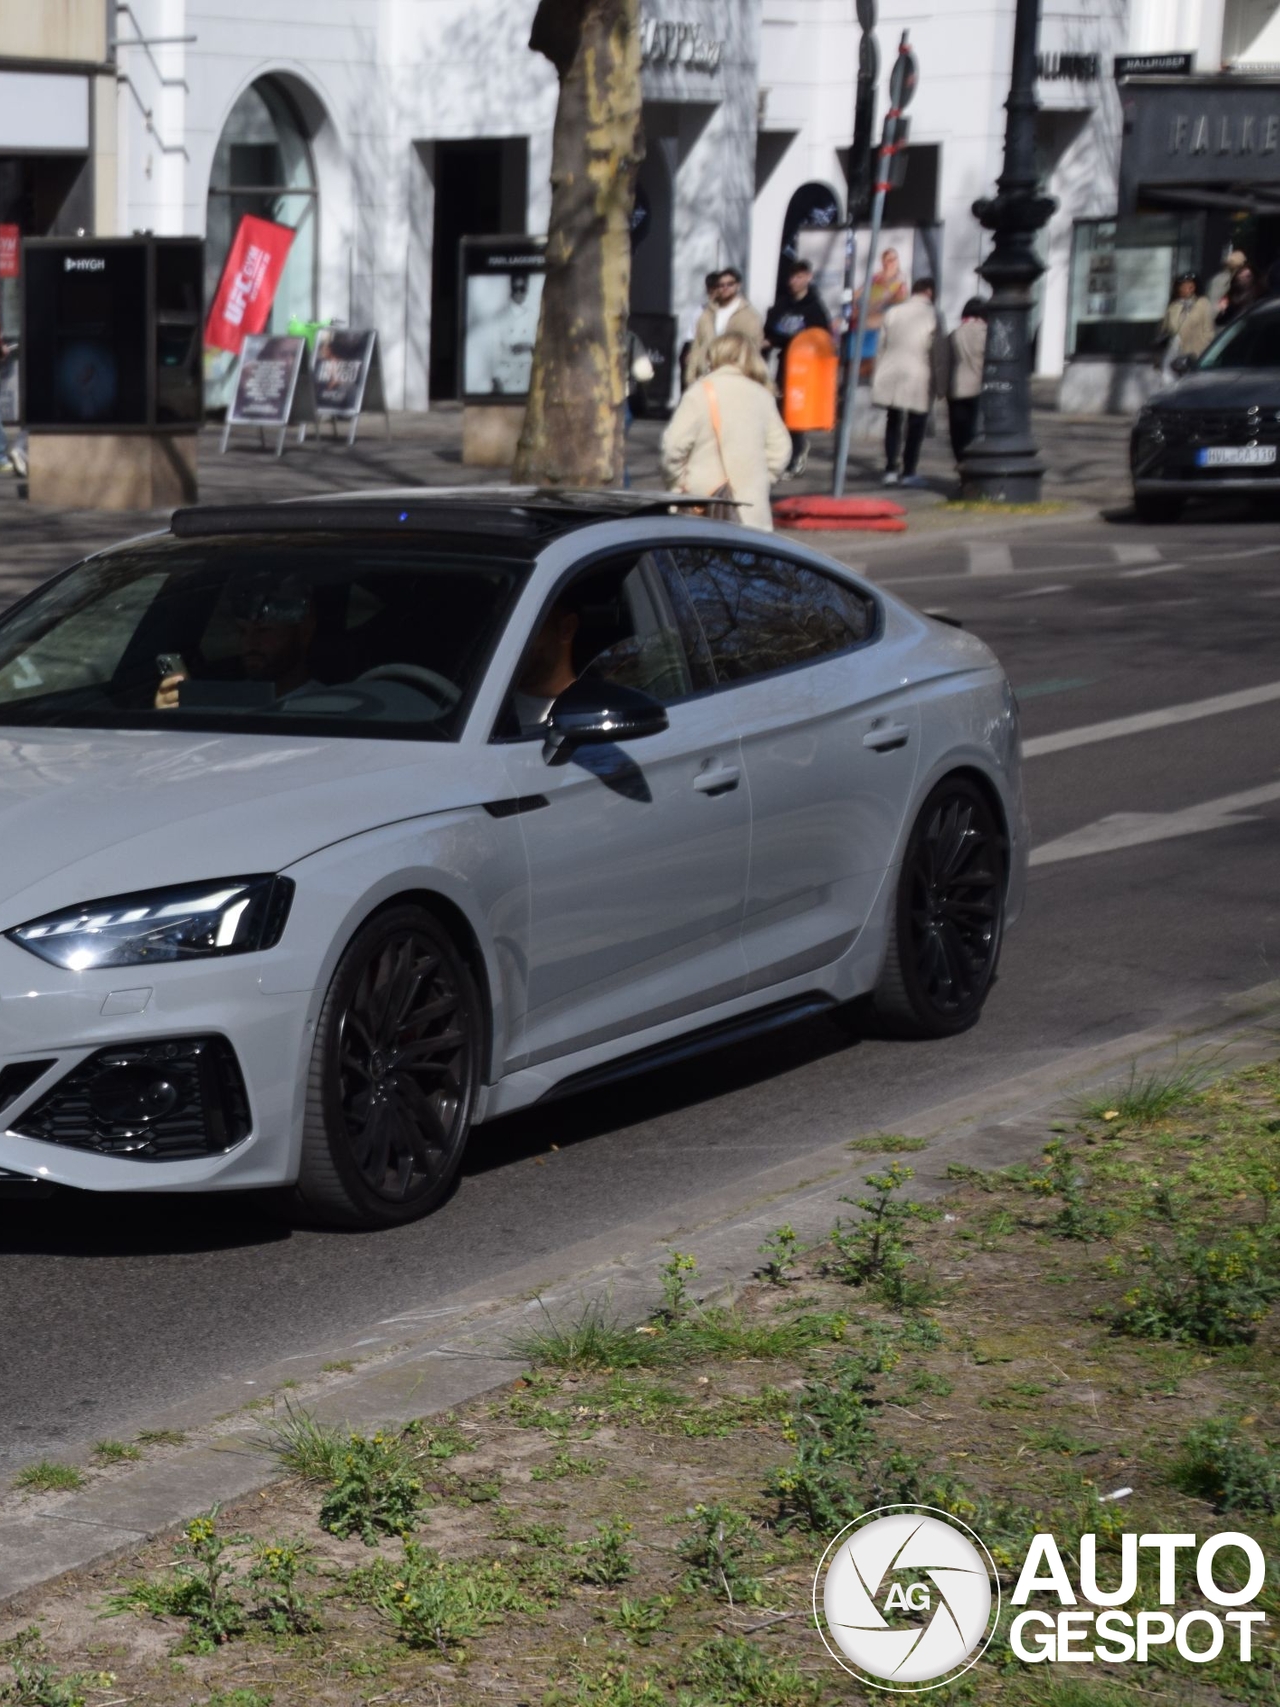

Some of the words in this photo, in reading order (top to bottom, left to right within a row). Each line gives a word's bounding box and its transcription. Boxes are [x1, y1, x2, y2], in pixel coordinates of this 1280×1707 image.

[1175, 115, 1279, 150] FALKE
[76, 258, 106, 271] HYGH
[223, 270, 253, 327] UFC
